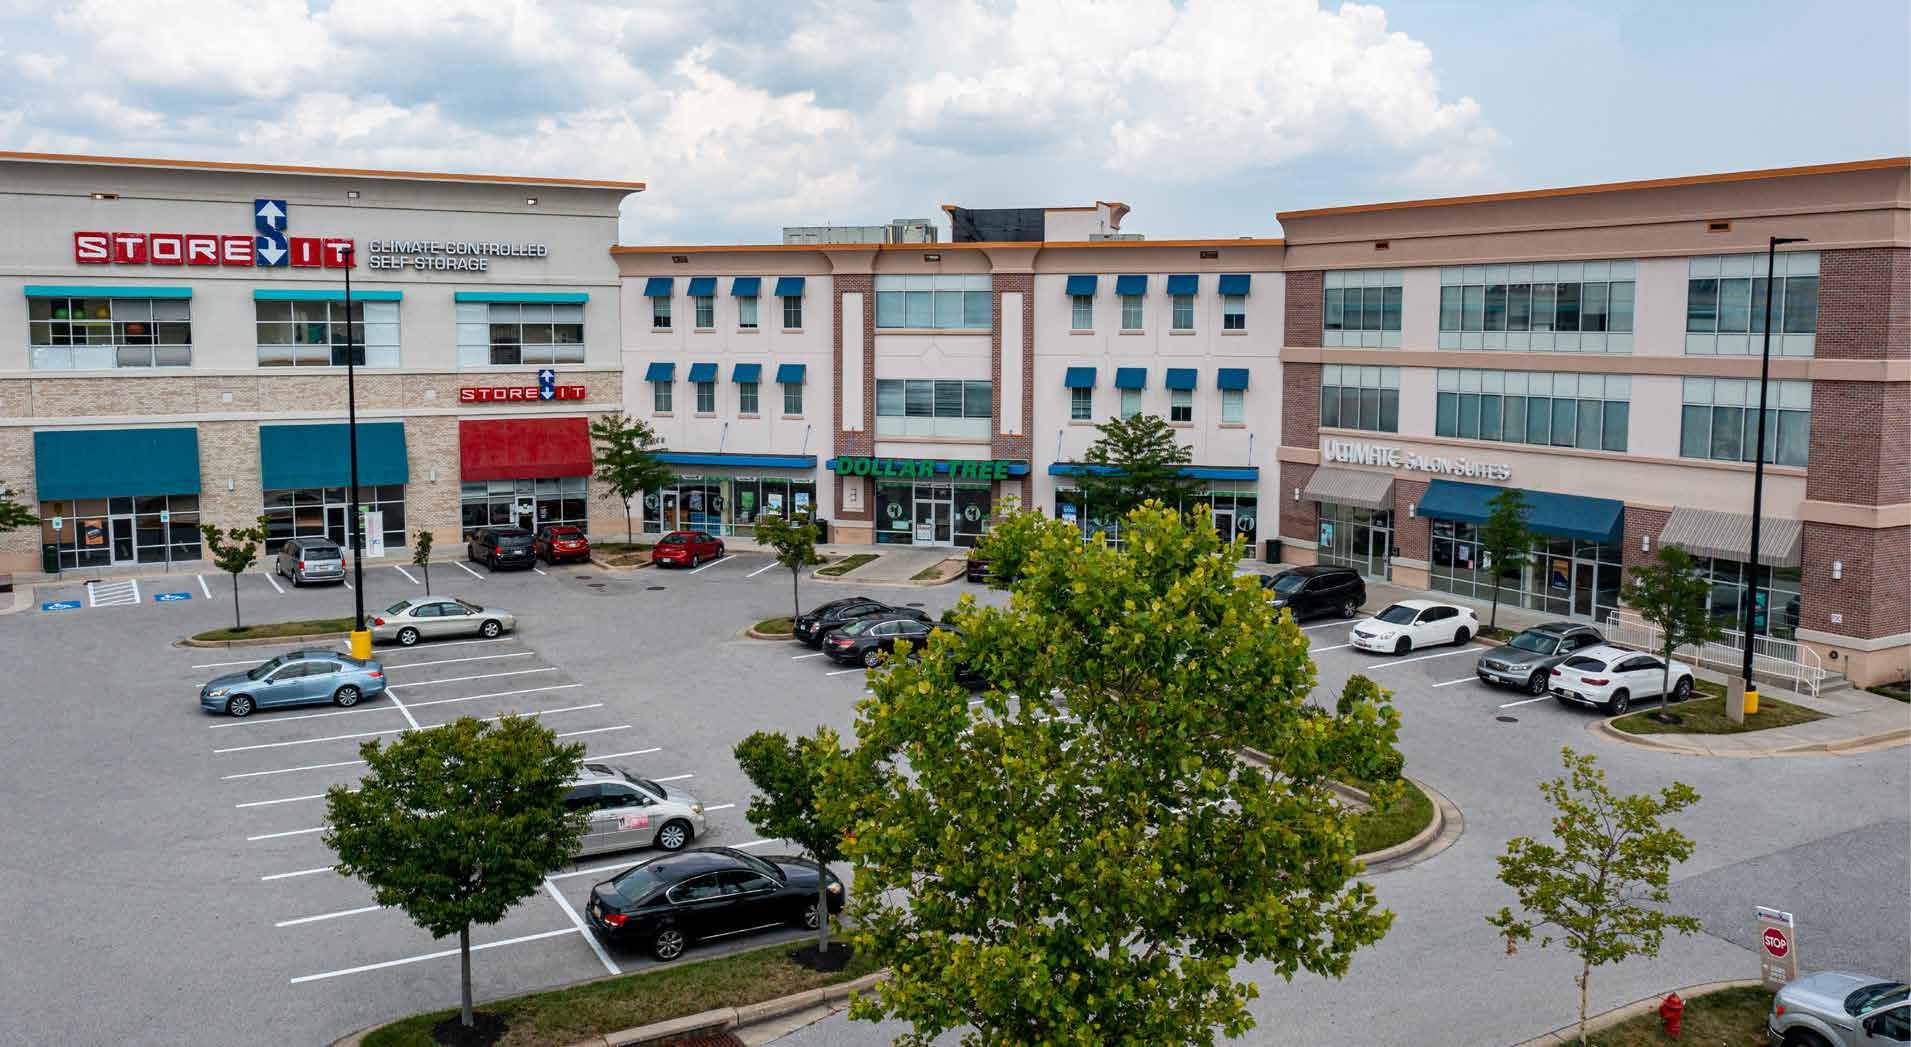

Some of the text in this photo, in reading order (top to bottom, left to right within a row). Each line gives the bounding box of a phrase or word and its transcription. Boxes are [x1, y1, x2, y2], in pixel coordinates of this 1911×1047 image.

[76, 235, 353, 264] STORE IT
[461, 386, 585, 400] STORE IT
[1325, 439, 1401, 467] ULTIMATE
[835, 456, 1009, 480] DOLLAR TREE
[1764, 935, 1787, 950] STOP
